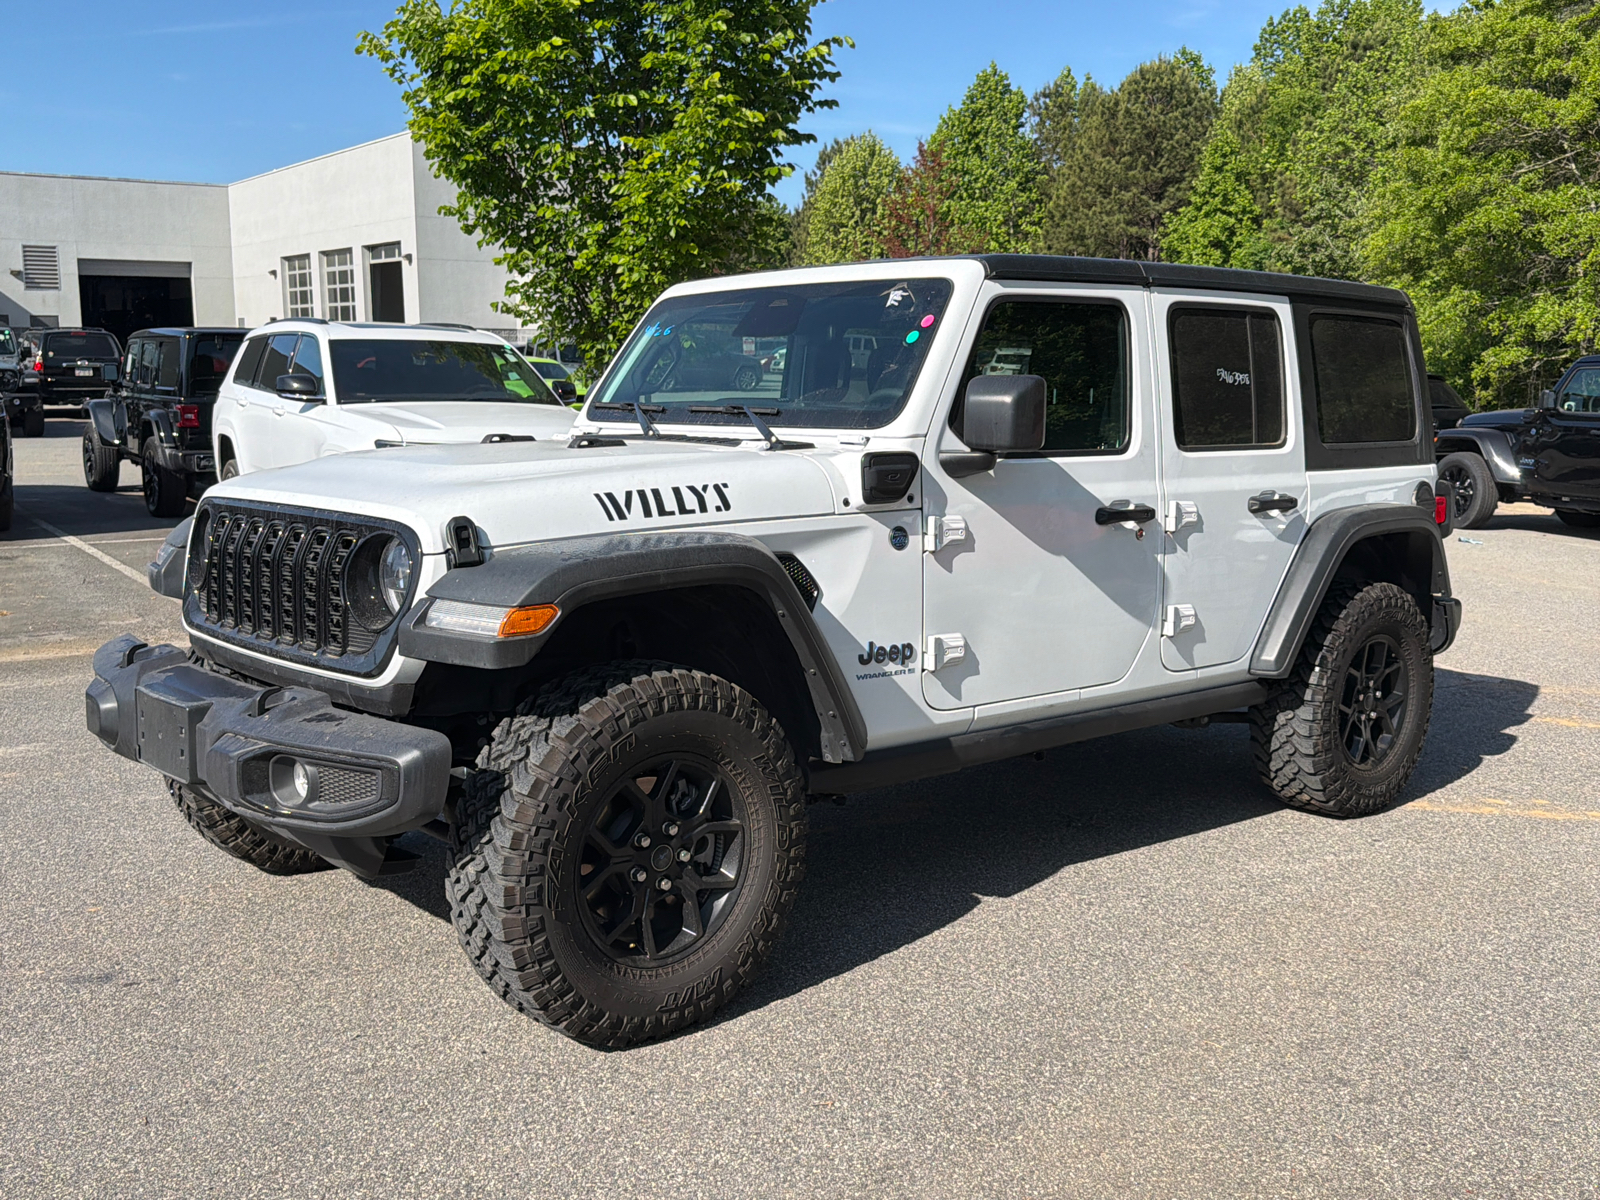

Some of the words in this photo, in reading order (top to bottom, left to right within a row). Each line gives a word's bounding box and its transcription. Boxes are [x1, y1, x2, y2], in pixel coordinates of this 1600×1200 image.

[593, 482, 732, 522] WILLYS
[858, 640, 914, 666] Jeep
[855, 669, 906, 681] WRANGLER
